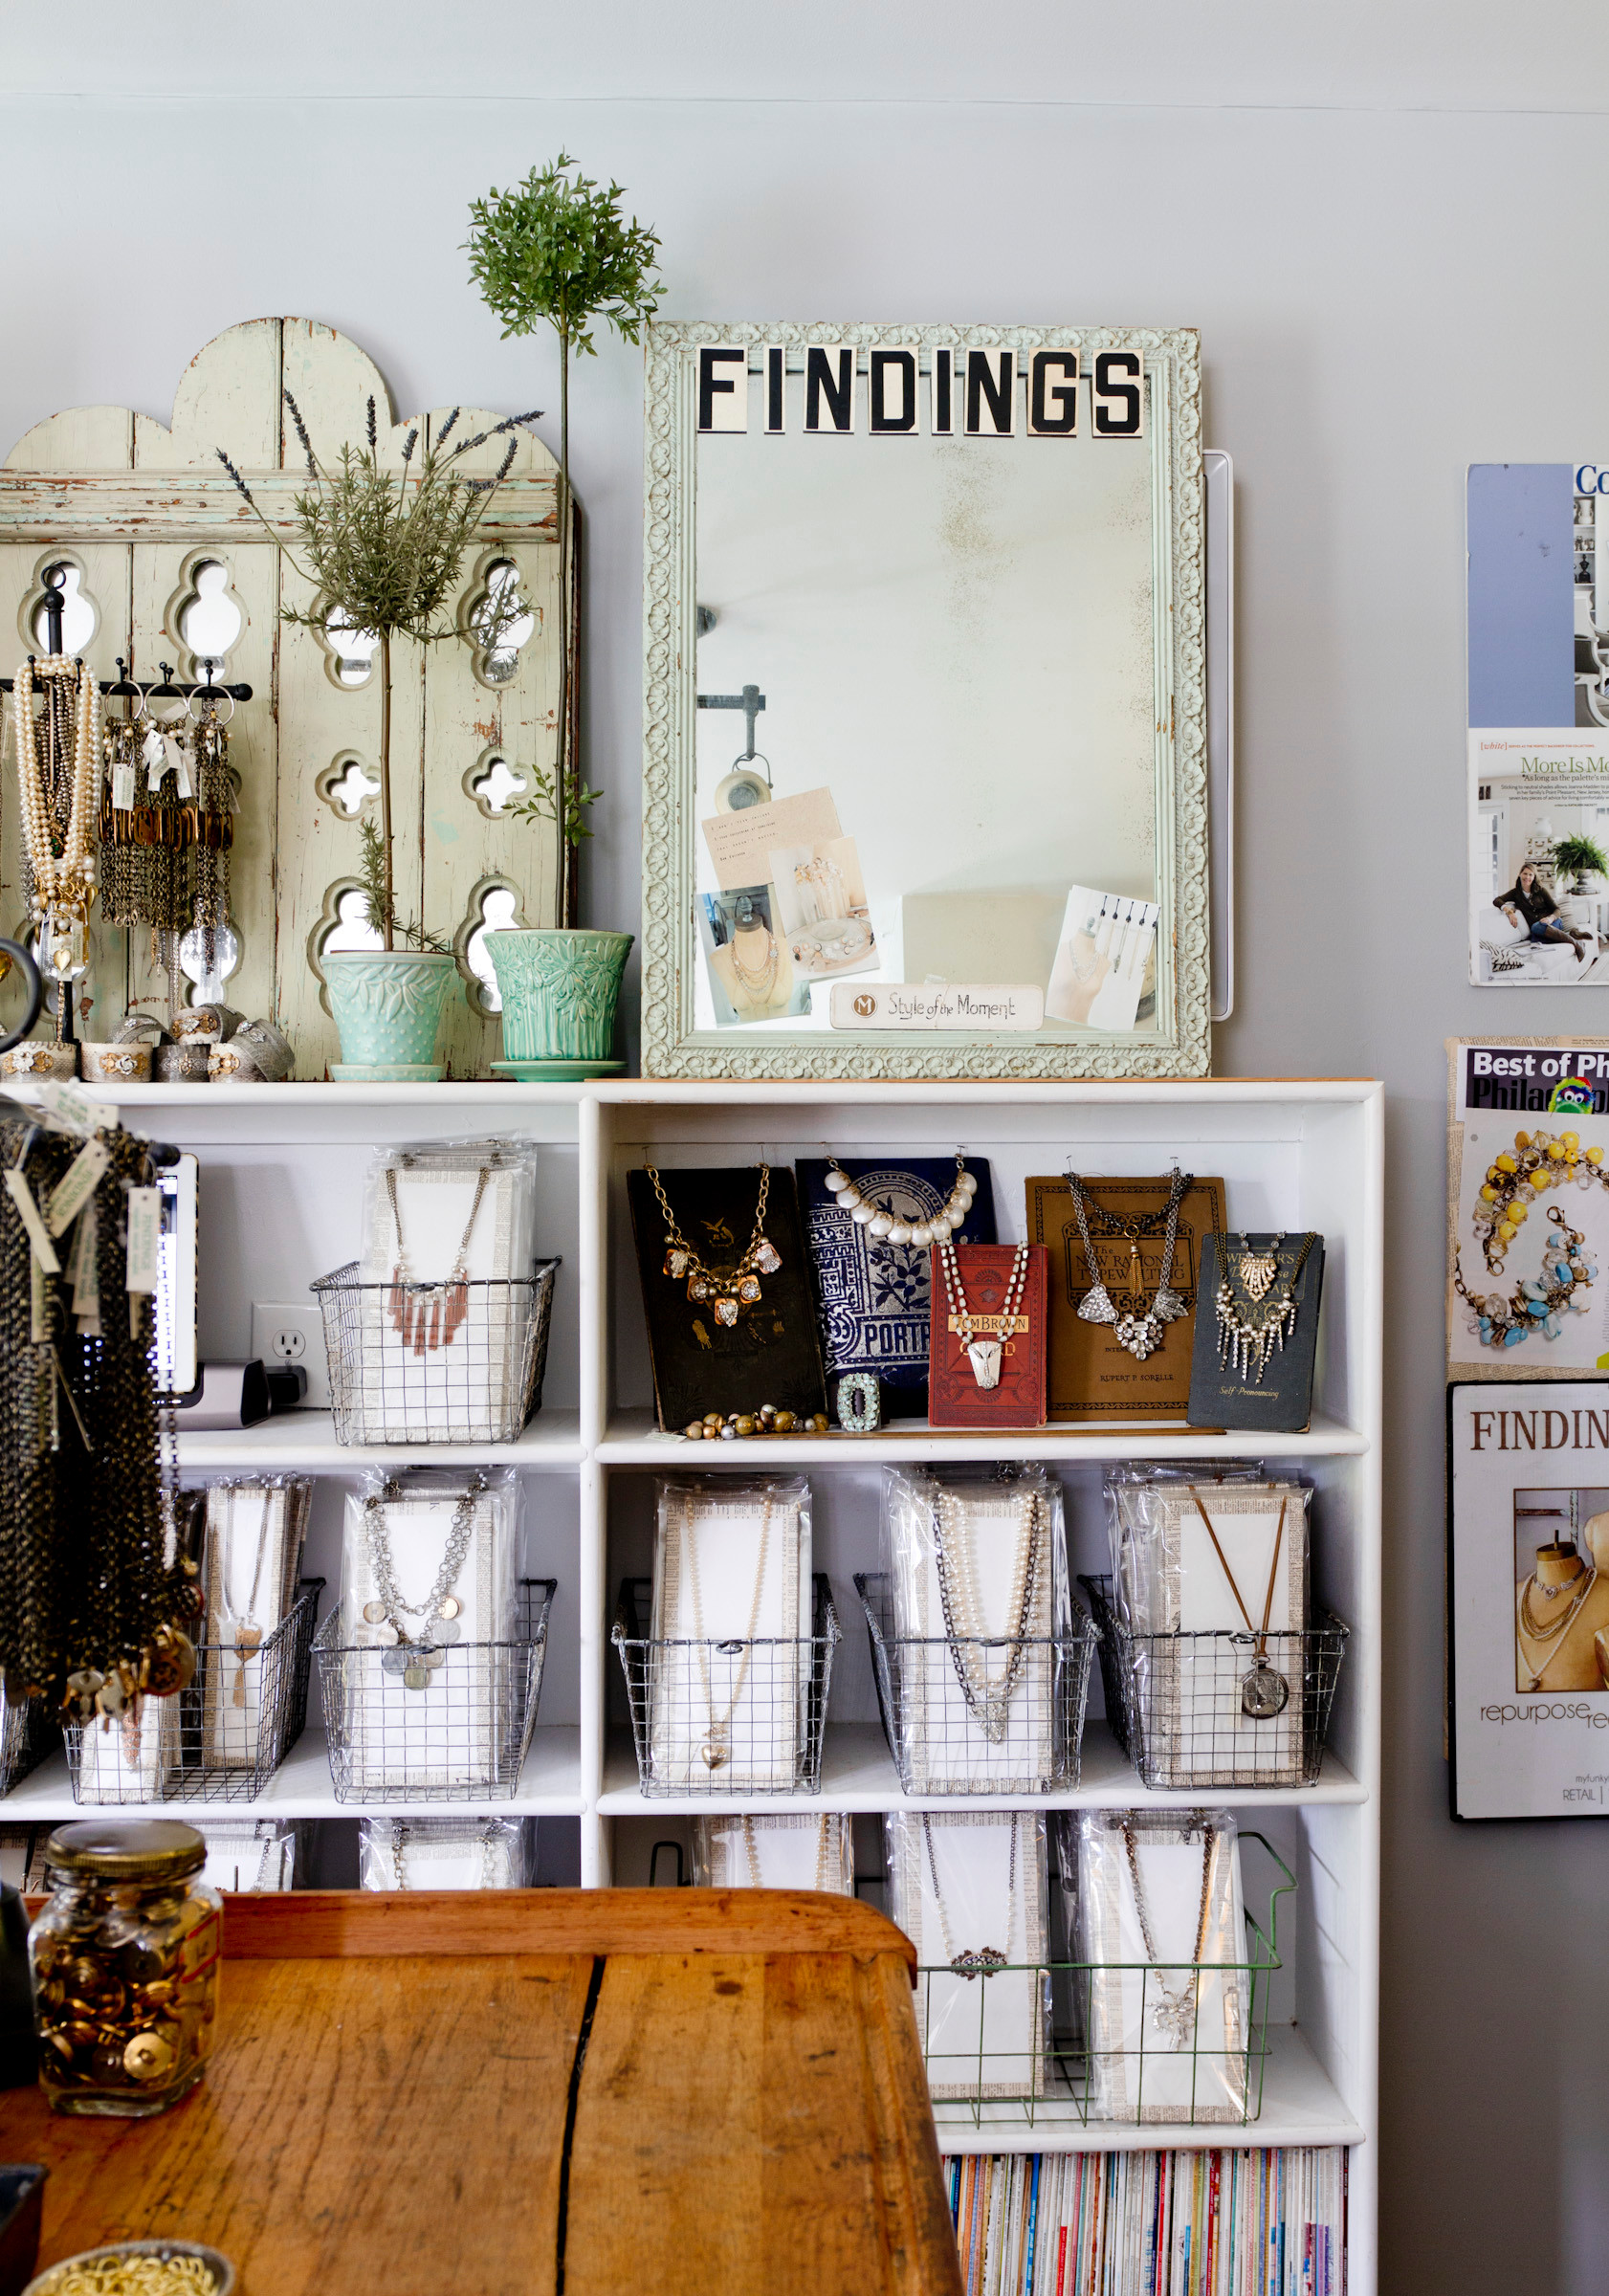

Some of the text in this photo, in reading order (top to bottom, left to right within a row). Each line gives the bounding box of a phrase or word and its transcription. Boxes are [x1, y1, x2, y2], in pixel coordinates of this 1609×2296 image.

[698, 348, 1139, 433] FINDINGS
[1521, 757, 1567, 773] More
[1569, 757, 1584, 773] Is
[1534, 774, 1550, 783] long
[889, 992, 924, 1020] Style
[925, 994, 942, 1020] of
[940, 1004, 953, 1017] the
[958, 995, 1016, 1020] Moment
[1474, 1052, 1536, 1076] Best
[1541, 1053, 1572, 1077] of
[1094, 1245, 1114, 1254] The
[1100, 1374, 1130, 1382] RUPERT
[1140, 1374, 1174, 1382] SORELLE
[1470, 1410, 1609, 1450] FINDIN
[1481, 1704, 1590, 1726] repurpose
[1587, 1712, 1609, 1729] re
[1563, 1788, 1597, 1800] RETAIL
